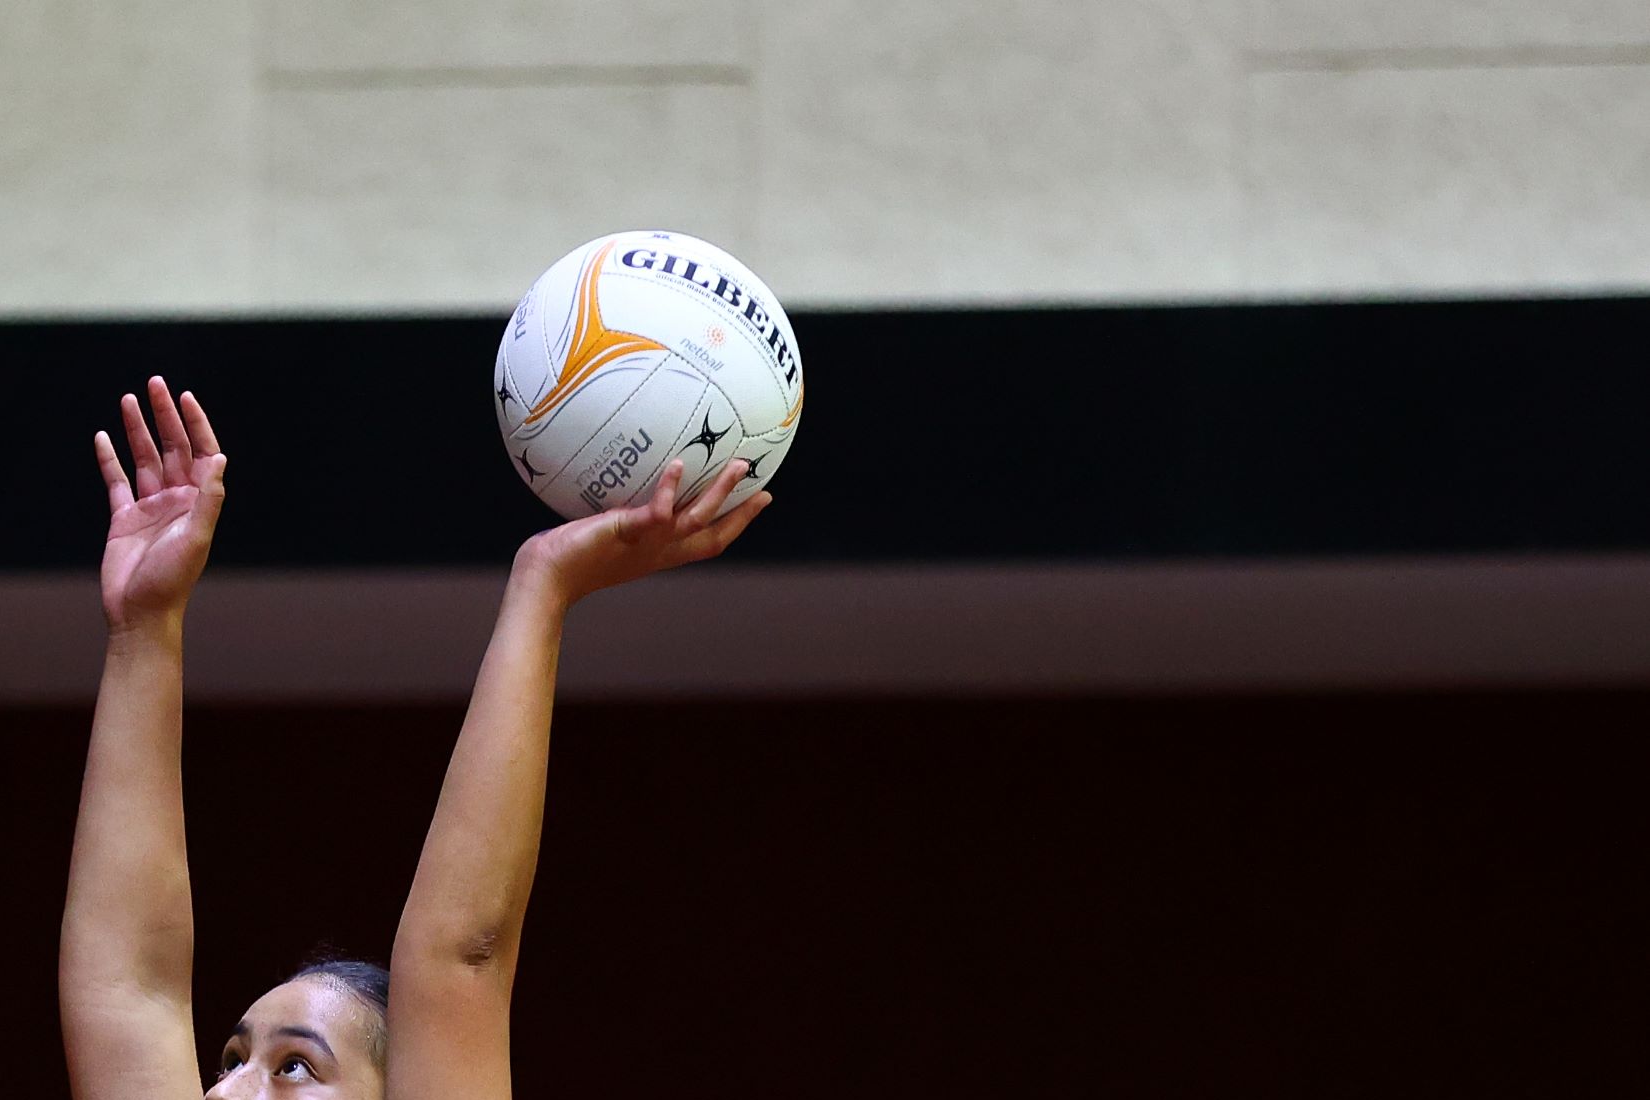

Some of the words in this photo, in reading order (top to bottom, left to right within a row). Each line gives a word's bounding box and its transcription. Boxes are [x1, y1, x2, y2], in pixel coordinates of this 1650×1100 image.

[621, 249, 800, 389] GILBERT
[680, 338, 725, 372] netball
[580, 428, 653, 511] netball
